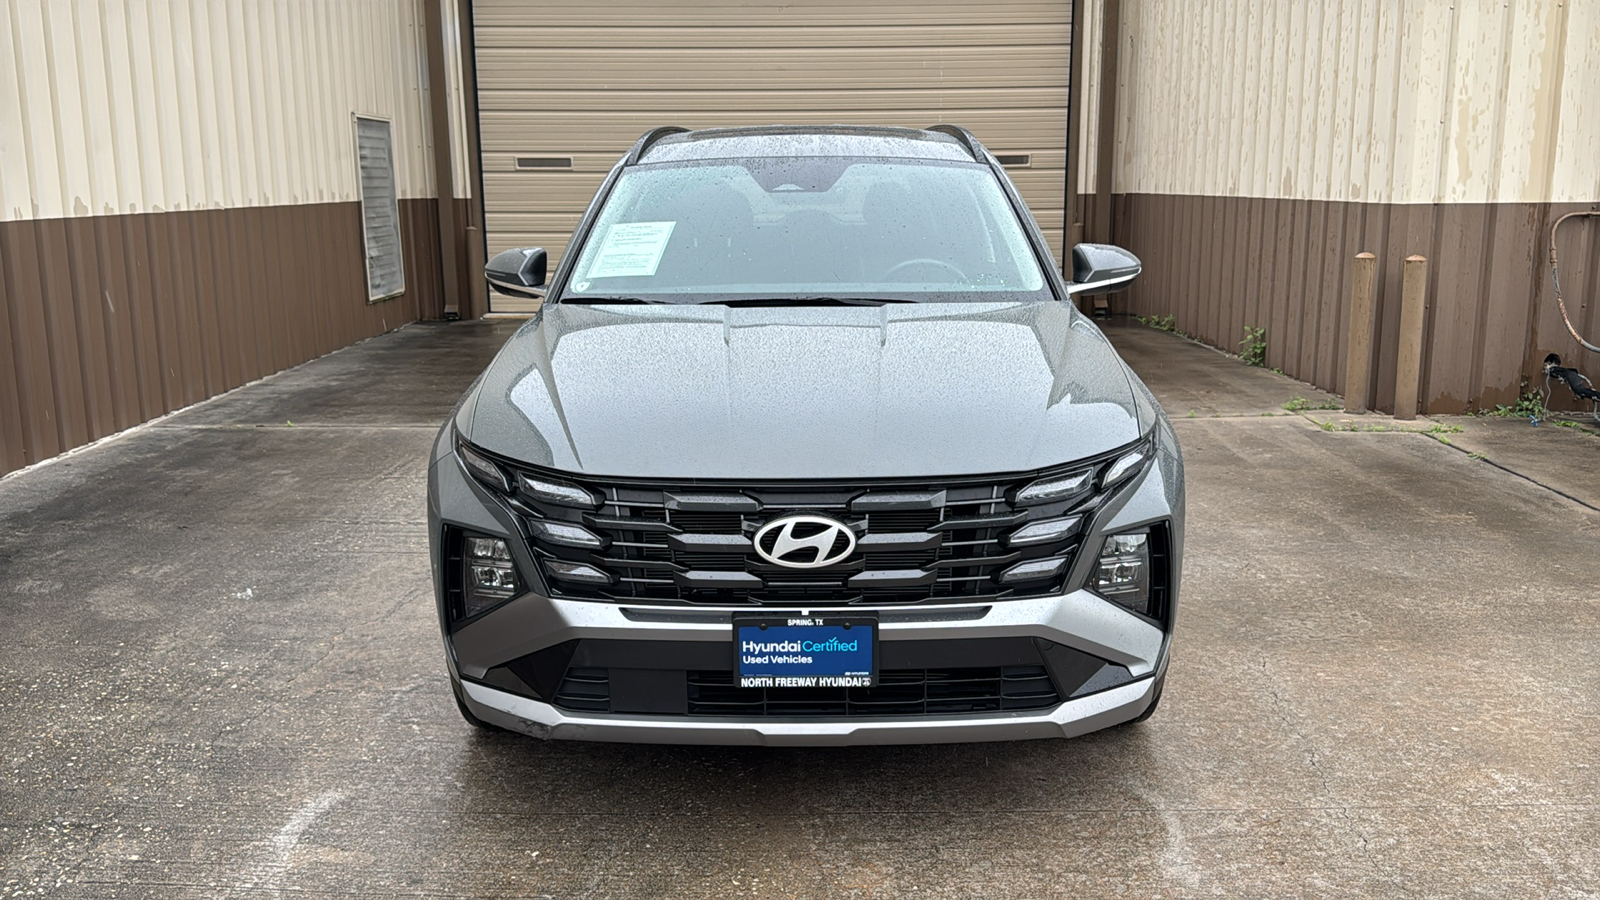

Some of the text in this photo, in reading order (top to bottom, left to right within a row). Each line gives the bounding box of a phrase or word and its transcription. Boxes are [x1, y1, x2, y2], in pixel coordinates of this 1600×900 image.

[742, 637, 857, 654] Hyundai Certified
[743, 654, 812, 664] Used Vehicles
[741, 677, 773, 688] NORTH
[775, 677, 817, 688] FREEWAY
[819, 676, 862, 687] HYUNDAI
